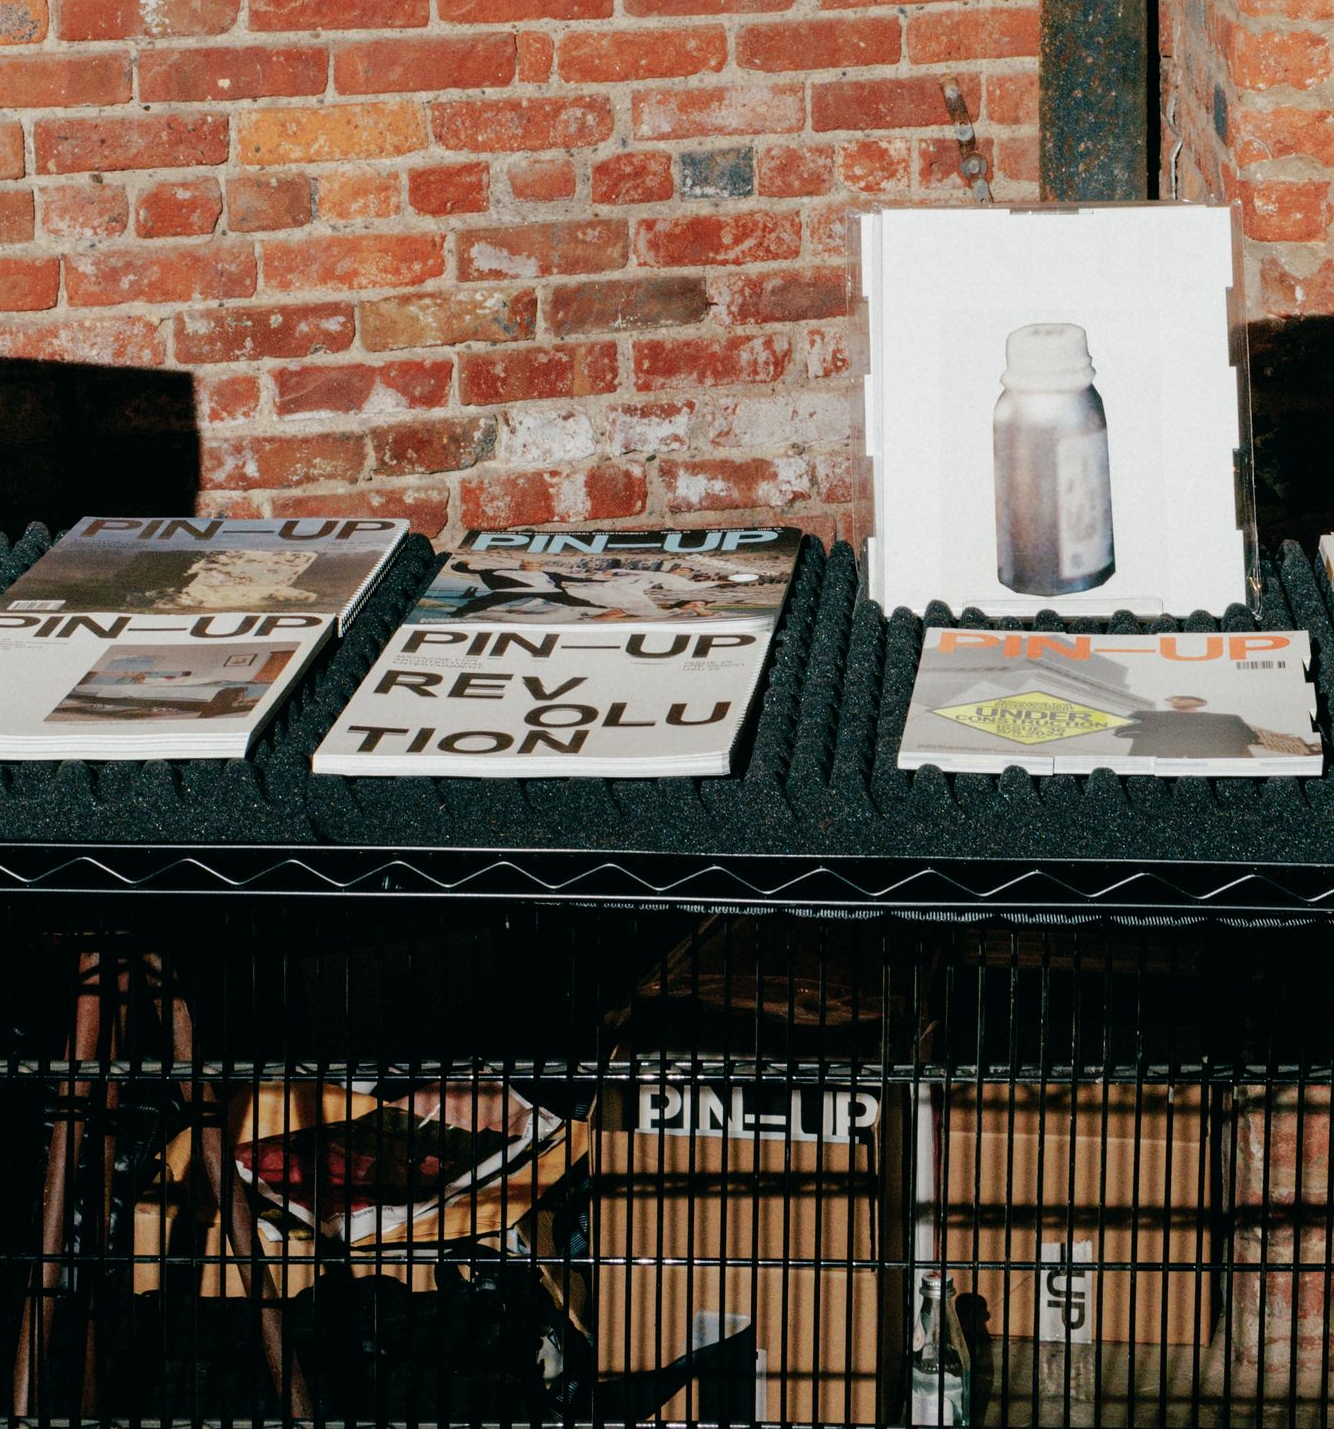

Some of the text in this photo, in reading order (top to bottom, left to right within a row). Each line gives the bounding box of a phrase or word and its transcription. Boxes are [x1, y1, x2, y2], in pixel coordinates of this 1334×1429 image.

[374, 670, 588, 701] REV
[524, 702, 731, 728] OLU
[955, 714, 1108, 728] CONSTRUCTION
[975, 707, 1092, 722] UNDER
[347, 727, 589, 754] TION
